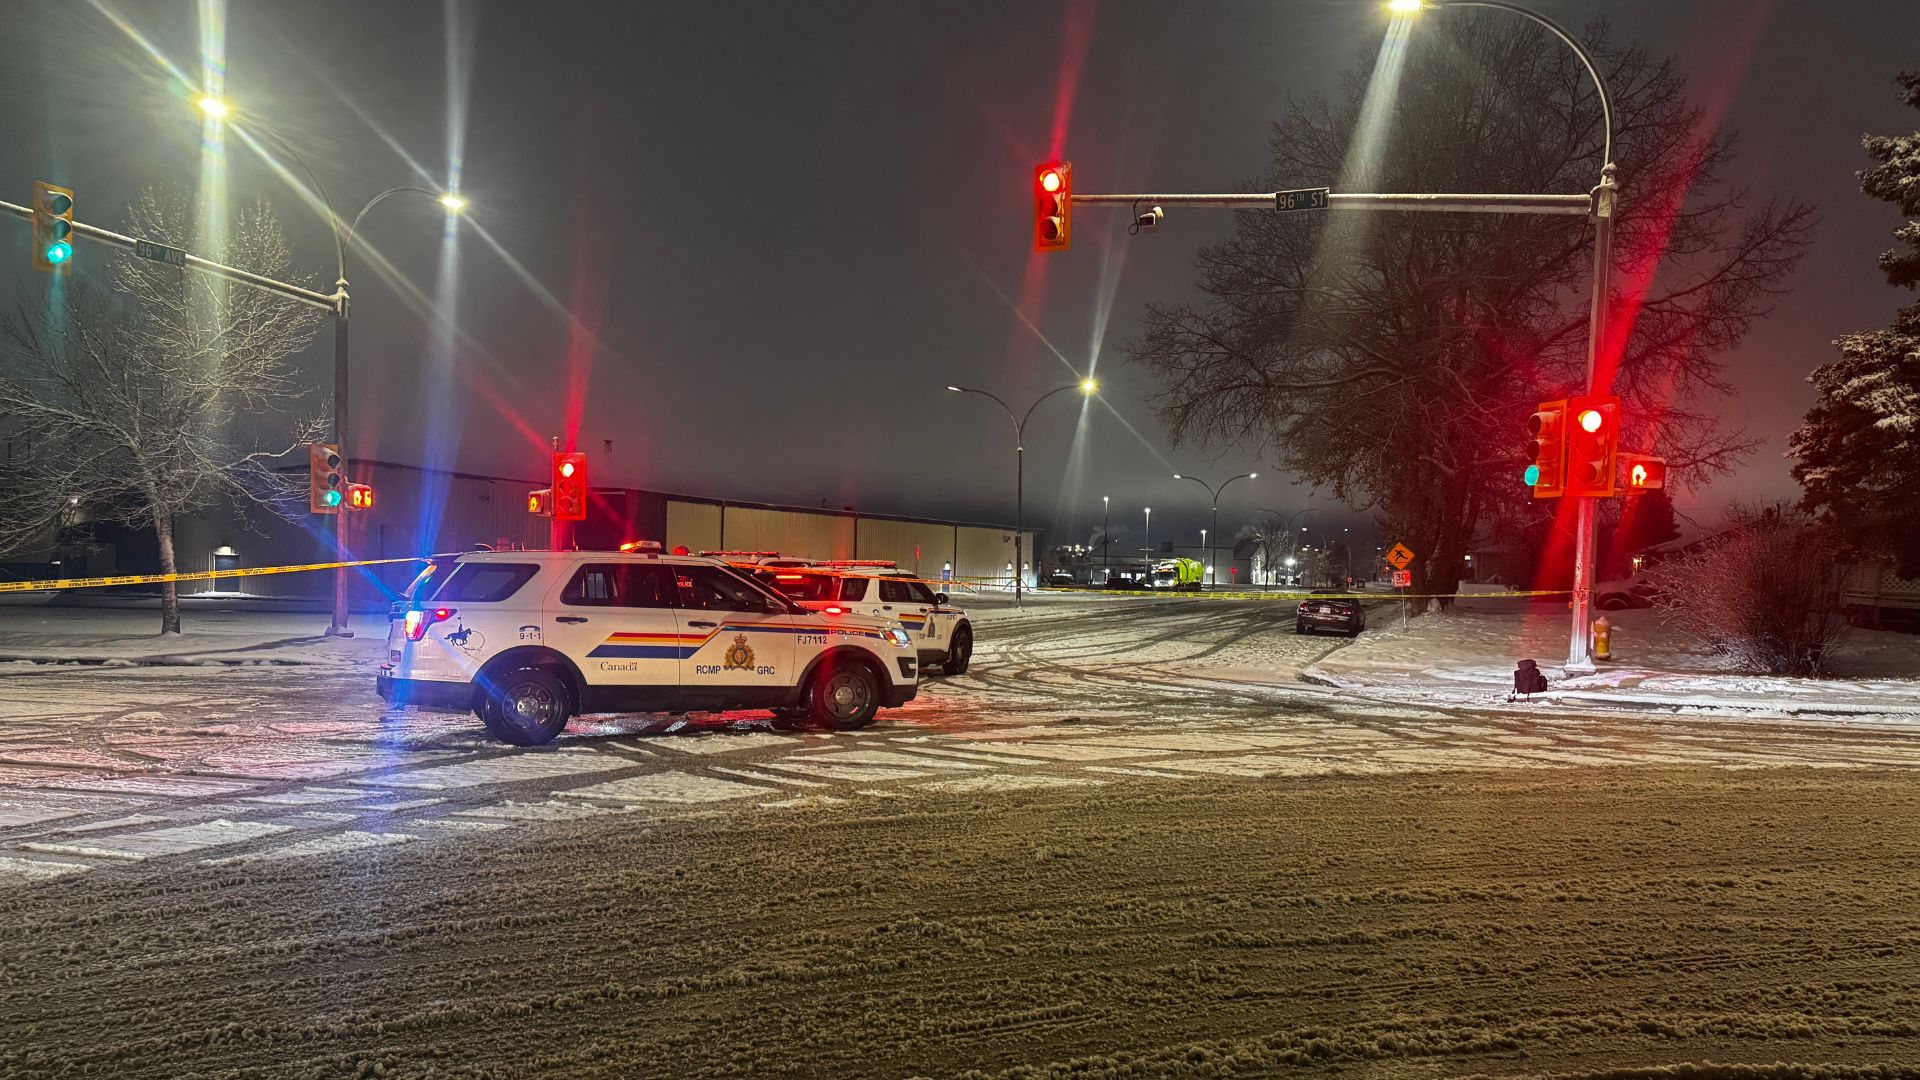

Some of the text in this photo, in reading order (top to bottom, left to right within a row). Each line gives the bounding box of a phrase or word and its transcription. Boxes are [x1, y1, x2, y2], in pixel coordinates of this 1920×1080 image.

[1279, 191, 1325, 209] 96TH ST
[831, 629, 865, 637] POLICE
[797, 635, 828, 645] FJ7112
[600, 661, 638, 671] Canada
[696, 665, 721, 675] RCMP
[757, 666, 775, 675] GRC
